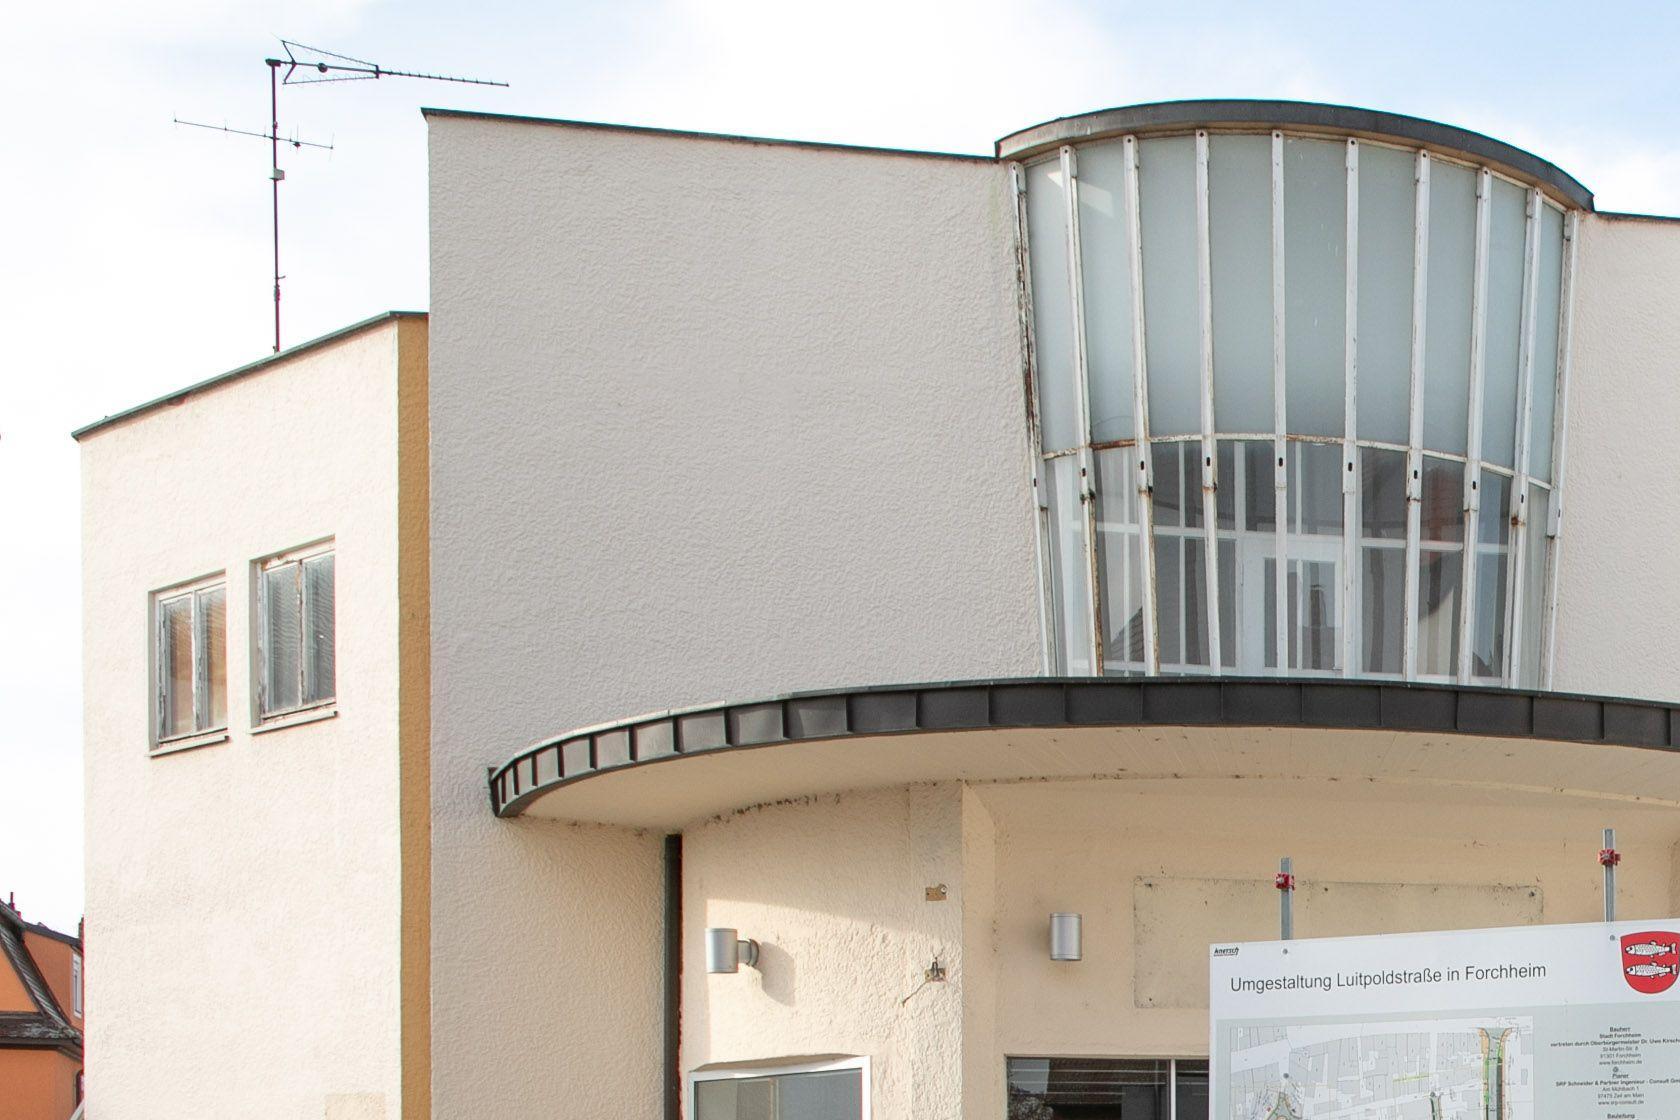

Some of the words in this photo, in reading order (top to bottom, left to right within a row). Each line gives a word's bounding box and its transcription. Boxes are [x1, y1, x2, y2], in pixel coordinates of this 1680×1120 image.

[1231, 976, 1332, 994] Umgestaltung
[1337, 968, 1442, 989] Luitpoldstraße
[1447, 967, 1459, 981] in
[1465, 963, 1546, 981] Forchheim
